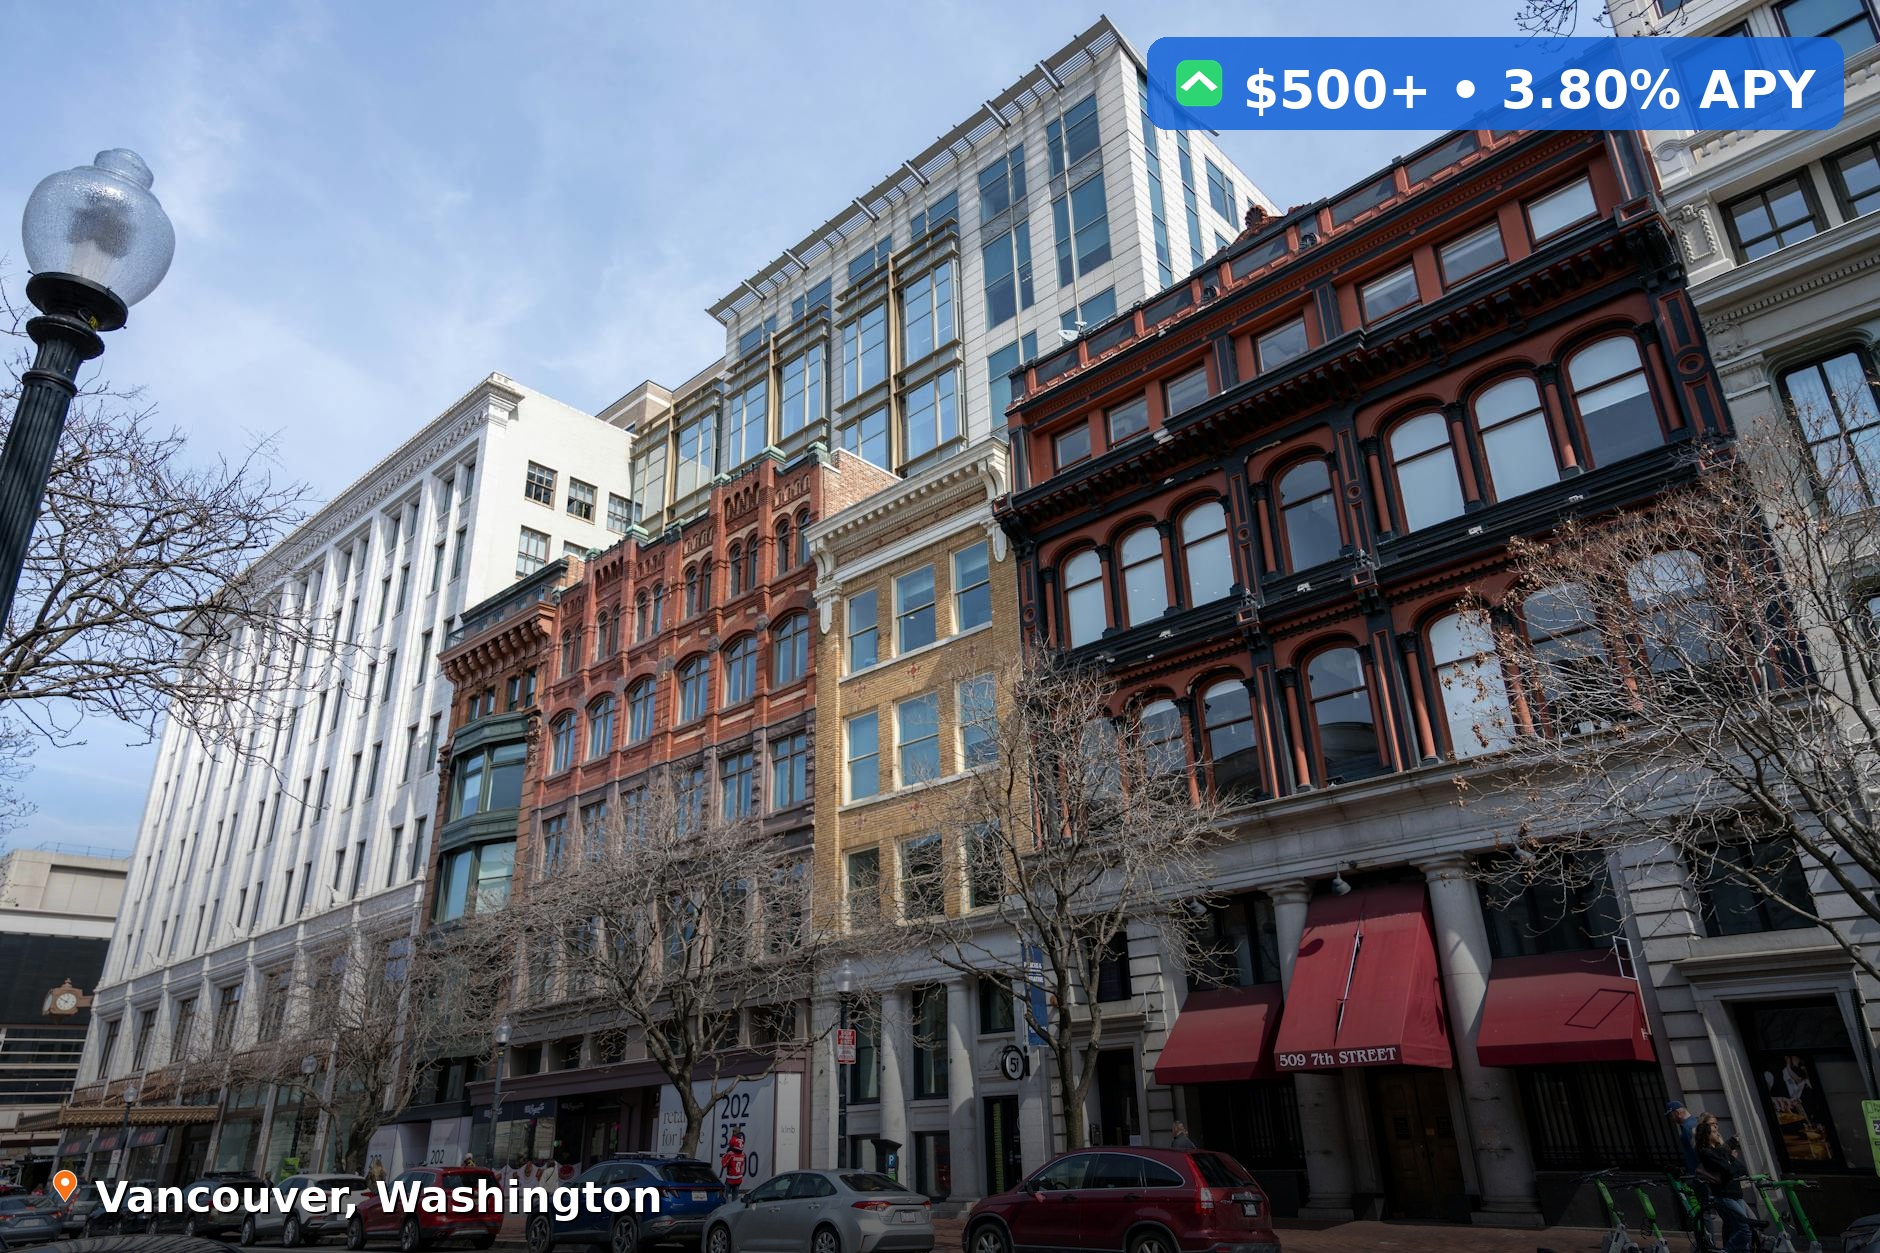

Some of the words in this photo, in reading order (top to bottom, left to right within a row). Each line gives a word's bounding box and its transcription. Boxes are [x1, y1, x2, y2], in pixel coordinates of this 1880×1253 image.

[1279, 1053, 1306, 1067] 509
[1310, 1052, 1335, 1066] 7th
[1338, 1047, 1397, 1064] STREET
[721, 1093, 750, 1119] 202
[662, 1128, 678, 1147] for
[430, 1149, 445, 1165] 202
